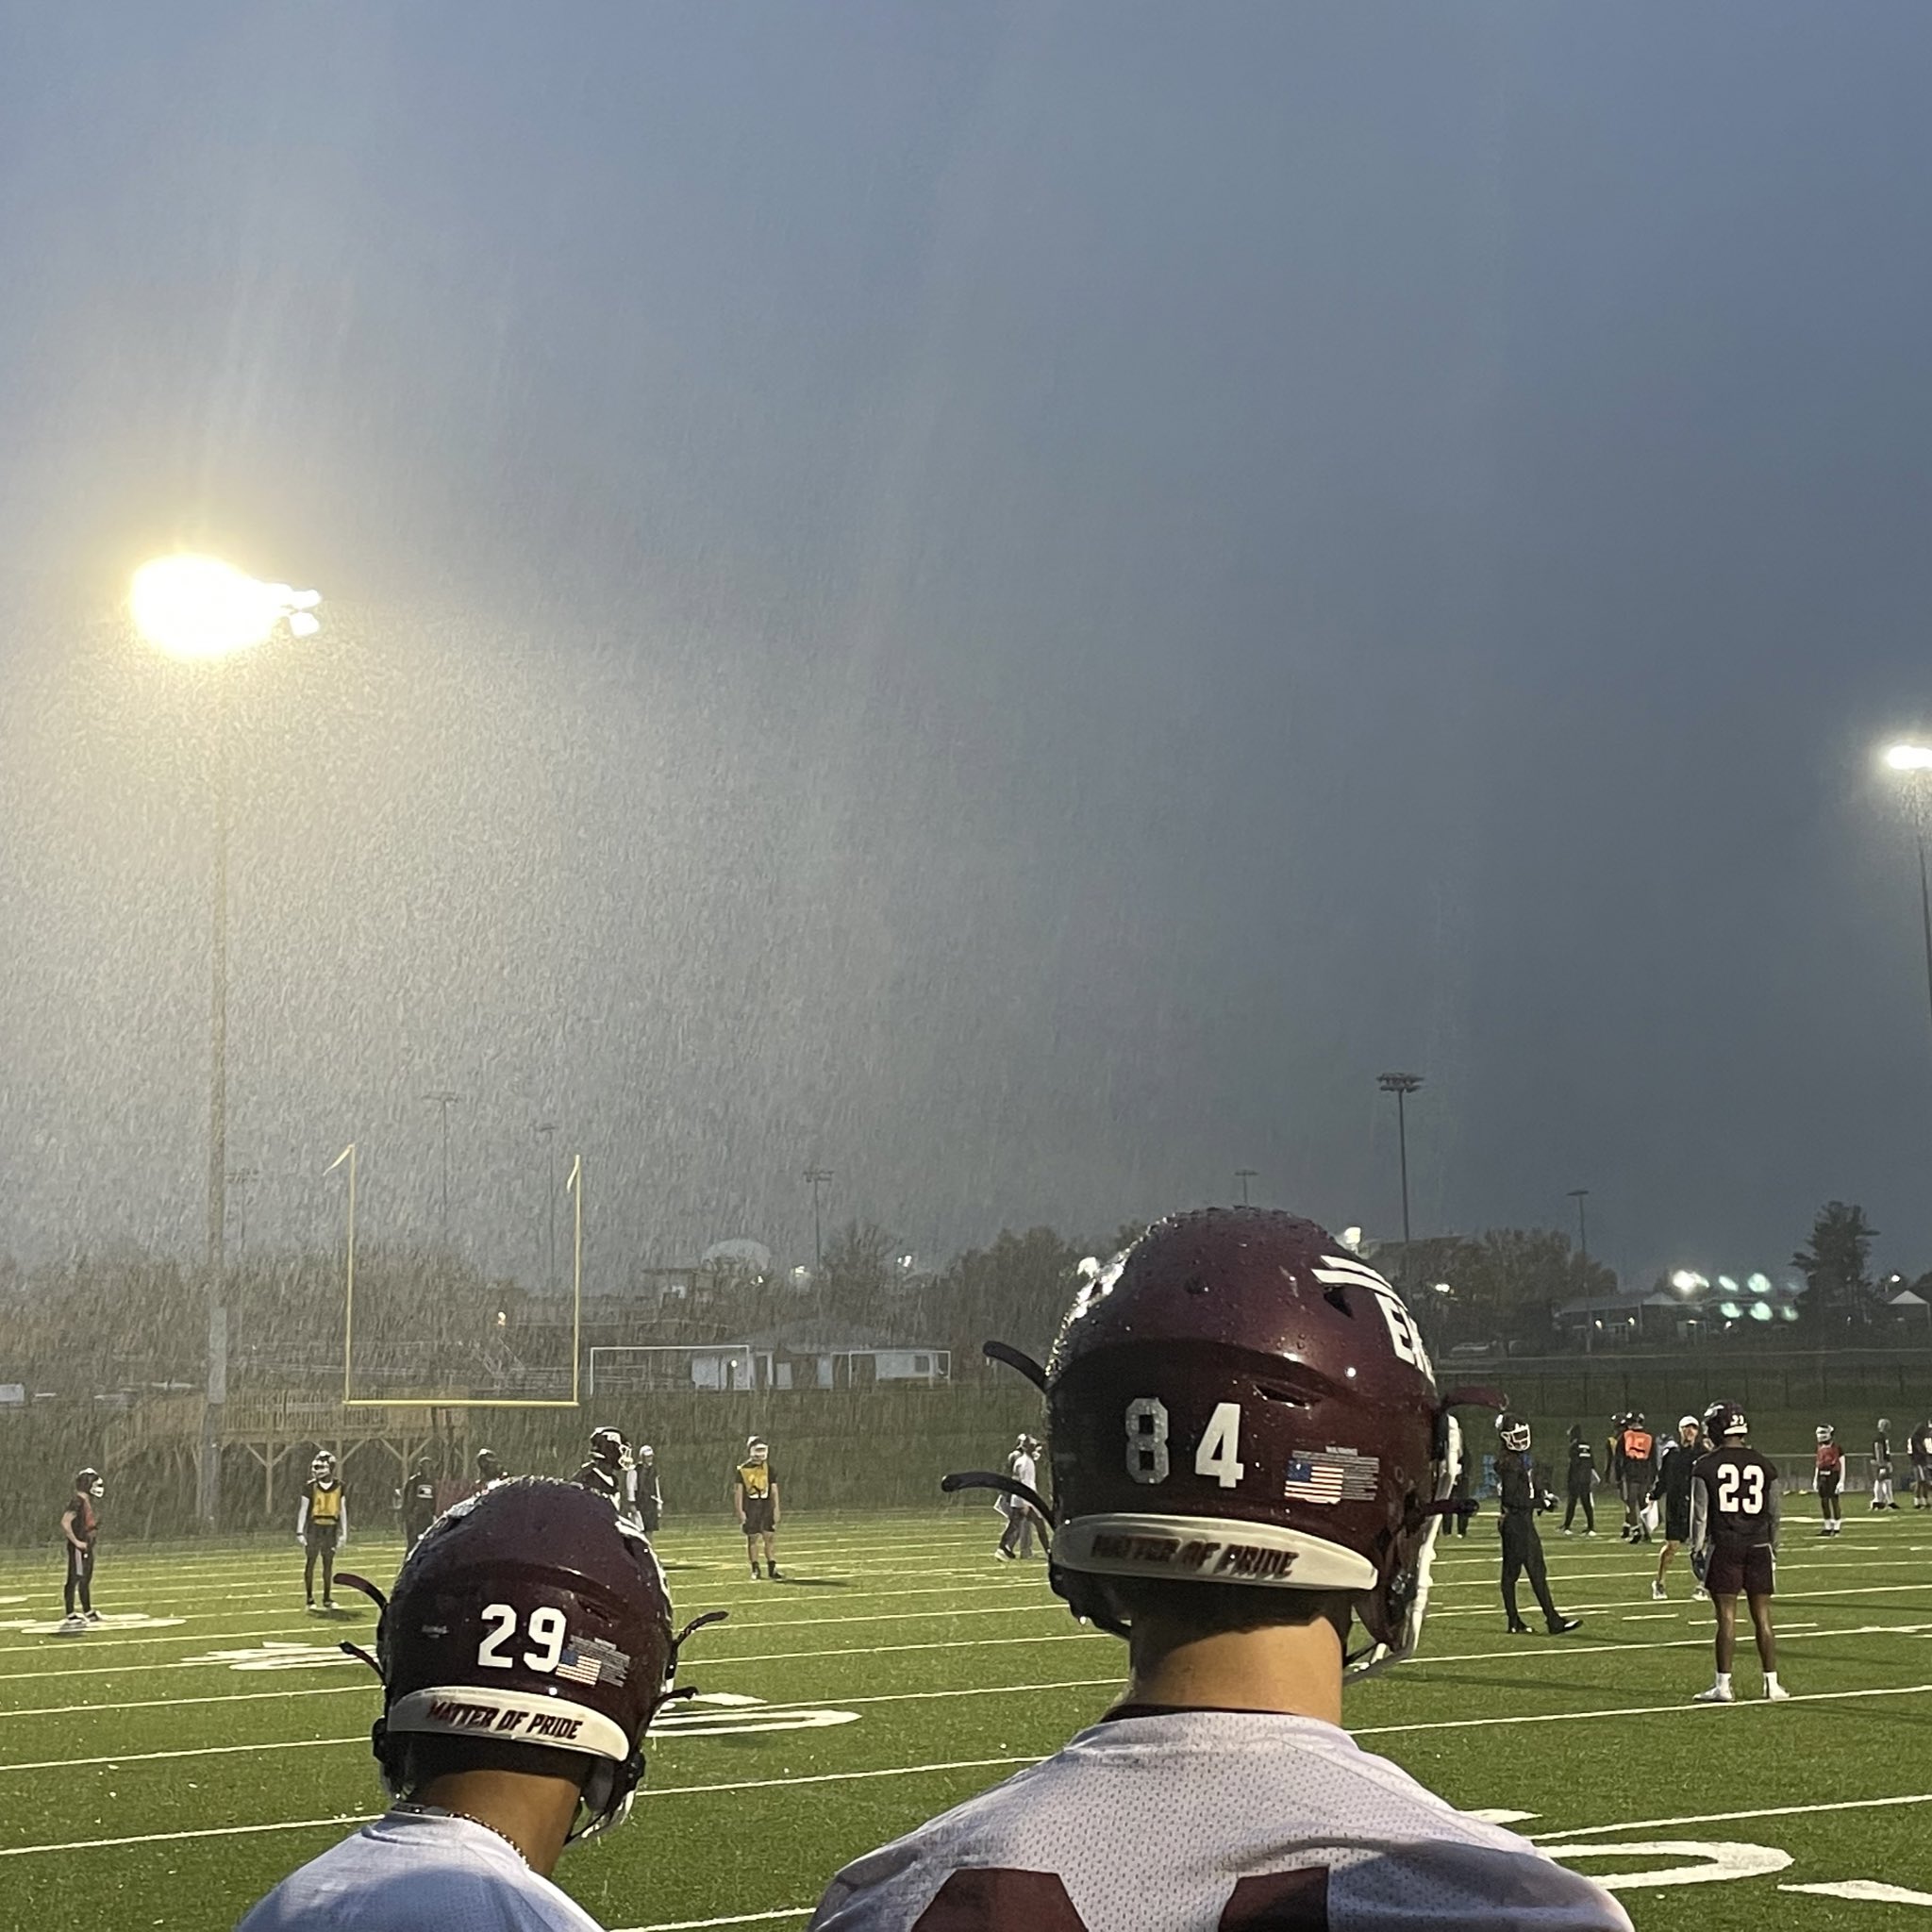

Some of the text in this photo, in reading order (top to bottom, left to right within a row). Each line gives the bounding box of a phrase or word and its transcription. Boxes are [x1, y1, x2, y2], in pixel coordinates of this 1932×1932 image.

[1124, 1397, 1244, 1488] 84
[1717, 1463, 1765, 1515] 23
[1213, 1542, 1300, 1577] PRIDE
[477, 1604, 566, 1673] 29
[426, 1701, 583, 1740] MATTER OF PRIDE
